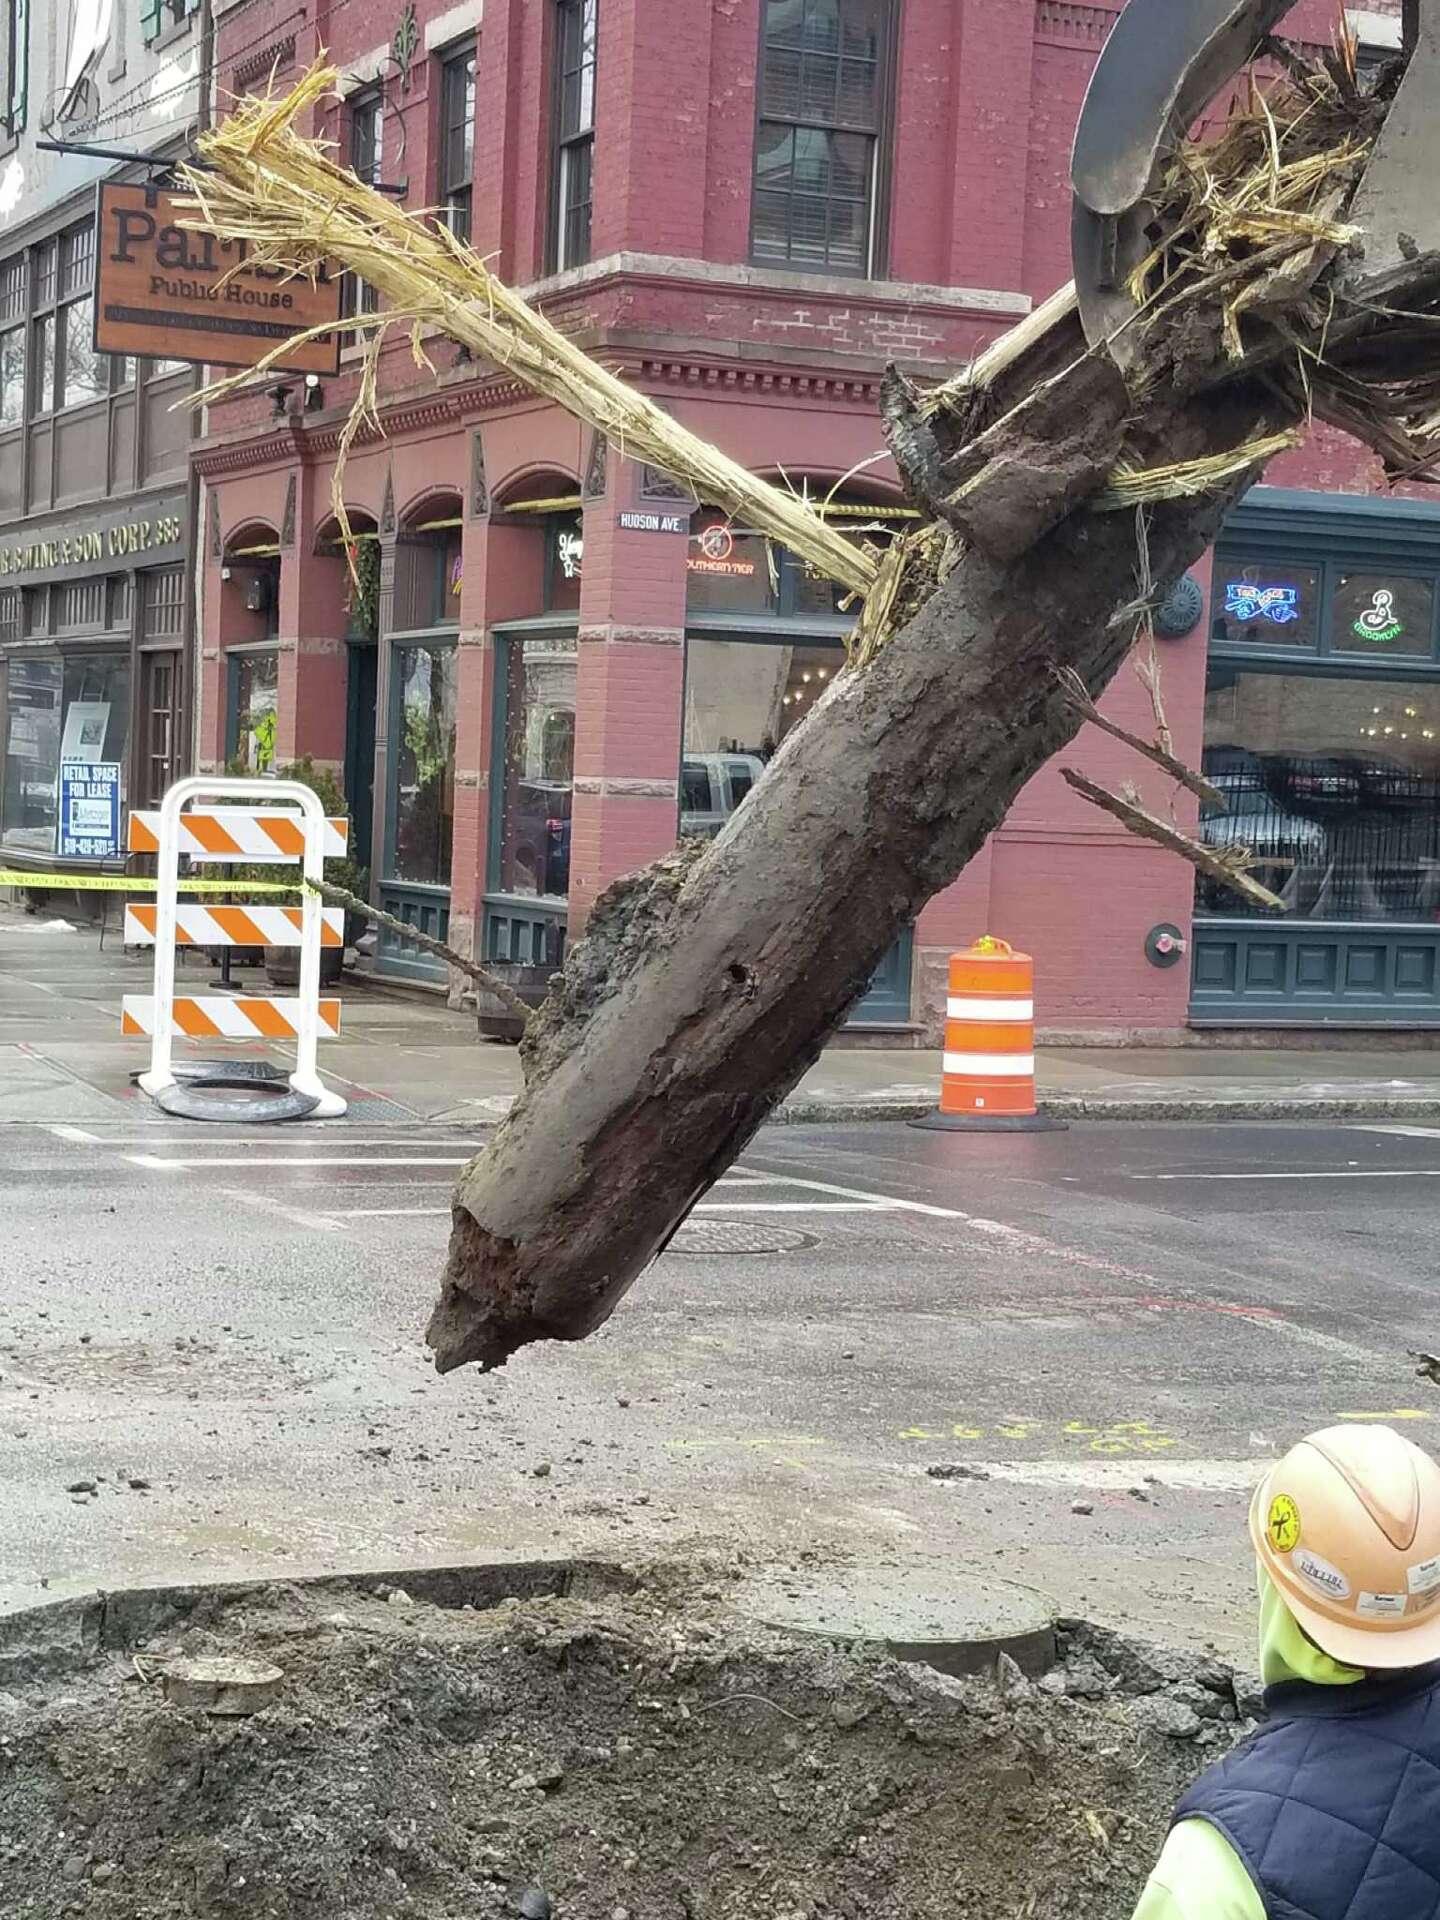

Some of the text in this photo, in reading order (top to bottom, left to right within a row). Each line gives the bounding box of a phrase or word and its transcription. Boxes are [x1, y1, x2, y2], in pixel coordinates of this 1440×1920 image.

[110, 207, 332, 286] Pari
[150, 276, 293, 310] Public House
[620, 513, 683, 532] HUDSON AVE.
[74, 531, 103, 563] SON
[108, 521, 152, 556] CORP.
[687, 560, 731, 572] OUTHERN
[1353, 622, 1402, 642] BROOKLYN
[63, 766, 118, 783] RETAIL SPACE
[69, 783, 112, 799] FOR LEASE
